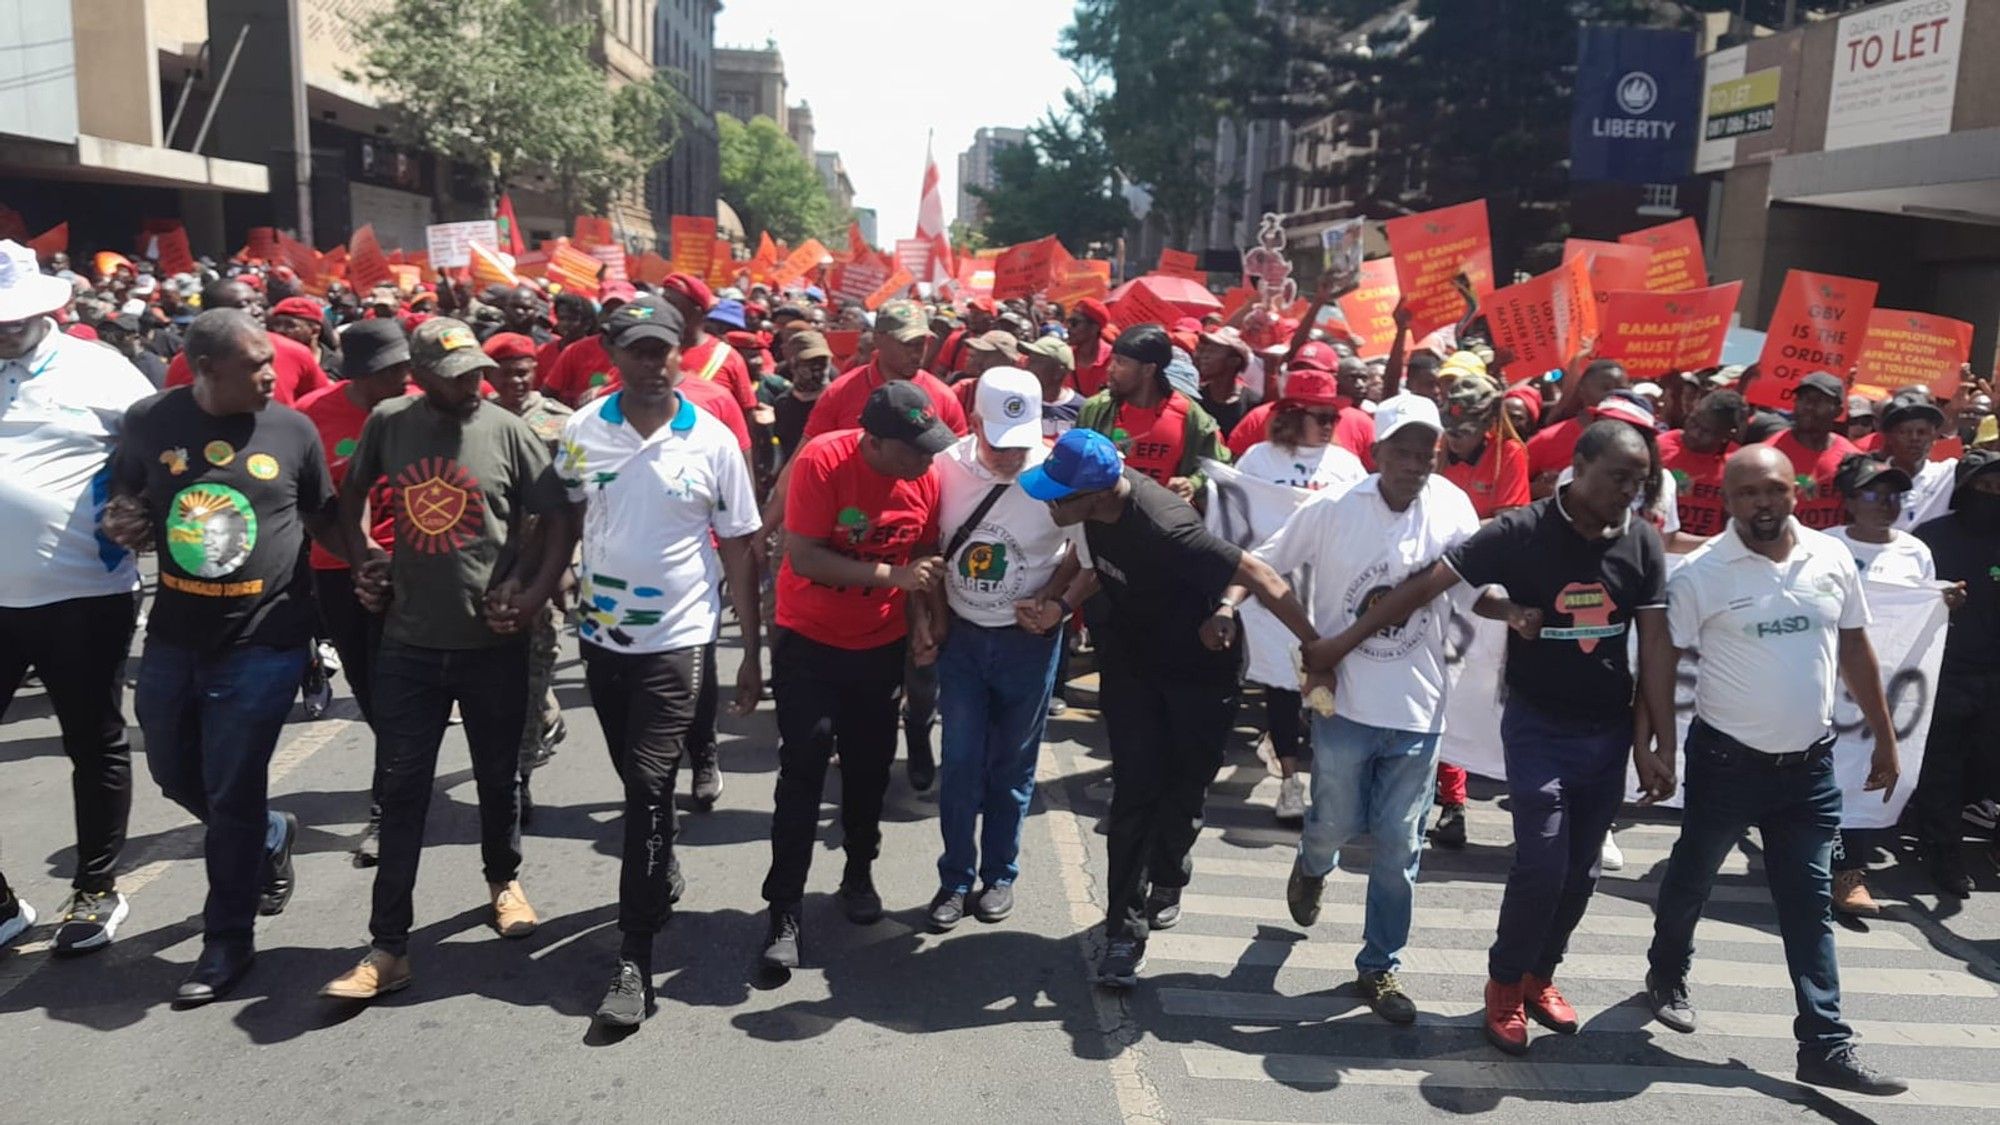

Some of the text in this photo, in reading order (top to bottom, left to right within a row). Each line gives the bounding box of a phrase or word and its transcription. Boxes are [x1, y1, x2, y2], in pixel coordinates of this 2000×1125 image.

[1848, 17, 1949, 72] TO LET
[1592, 117, 1677, 141] LIBERTY
[1808, 304, 1845, 321] GBV
[1617, 315, 1721, 336] RAMAPHOSA
[1792, 323, 1847, 345] IS THE
[1625, 341, 1673, 354] MUST
[1867, 328, 1957, 348] UNEMPLOYMENT
[1781, 344, 1844, 368] ORDER
[1883, 340, 1937, 356] IN SOUTH
[1674, 349, 1712, 368] NOW
[1905, 354, 1951, 370] CANNOT
[1774, 364, 1801, 381] OF
[1136, 442, 1171, 459] EFF
[1678, 505, 1715, 523] OTE
[1757, 615, 1810, 638] F4SD
